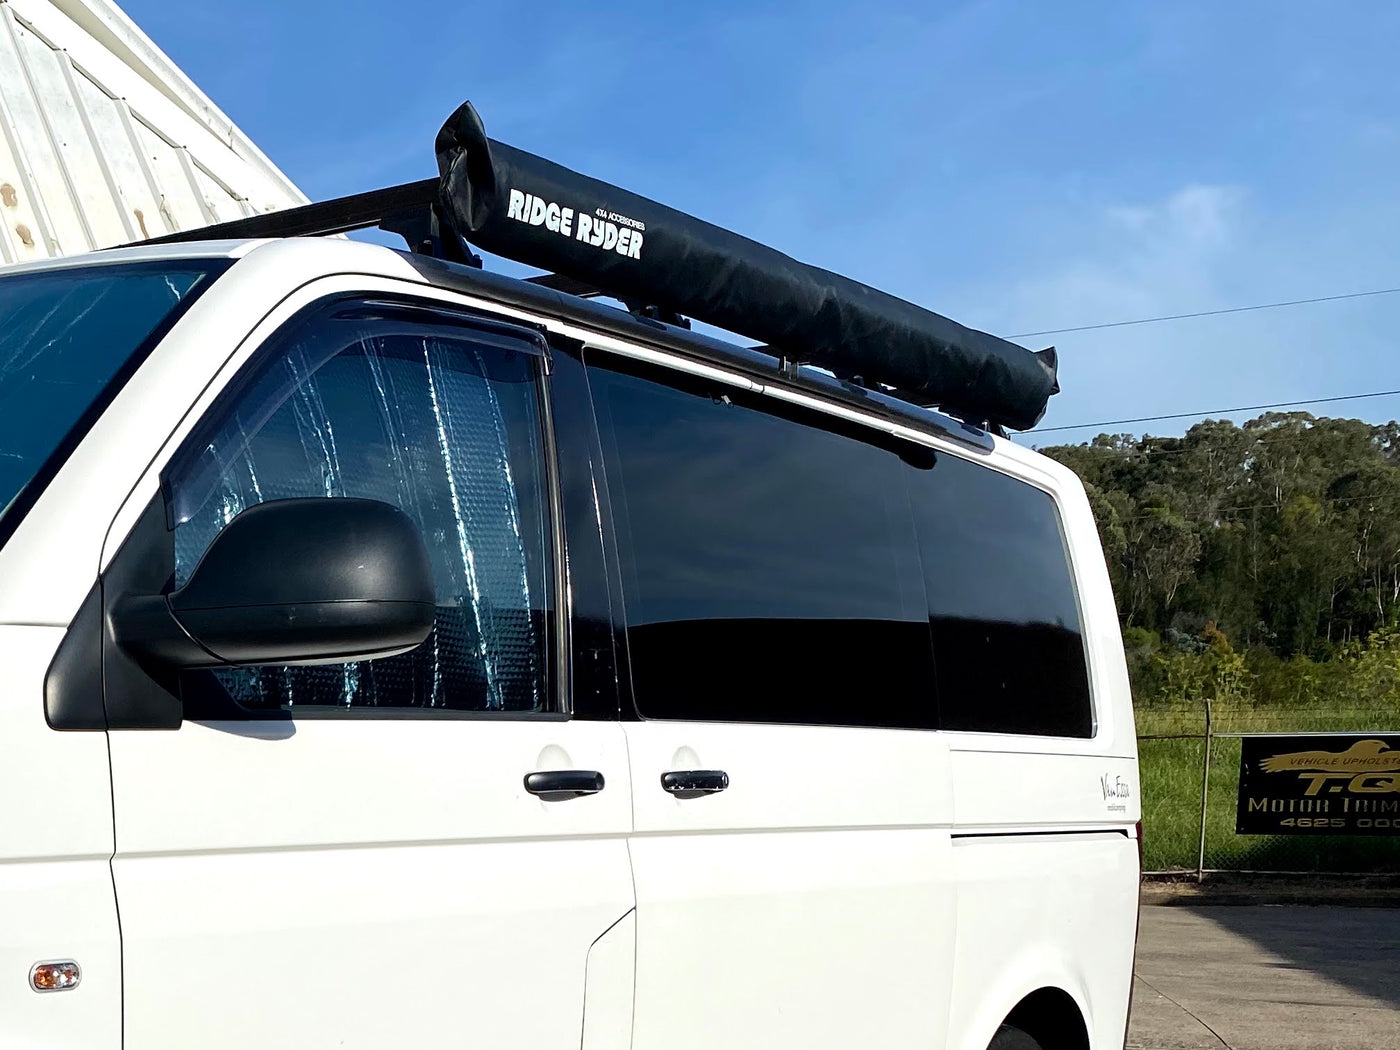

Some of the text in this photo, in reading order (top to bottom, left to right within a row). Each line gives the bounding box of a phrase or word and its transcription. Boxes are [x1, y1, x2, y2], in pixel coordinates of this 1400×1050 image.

[507, 188, 644, 260] RIDGE RYDER
[1289, 757, 1338, 766] VEHICLE
[1280, 818, 1346, 828] 4625
